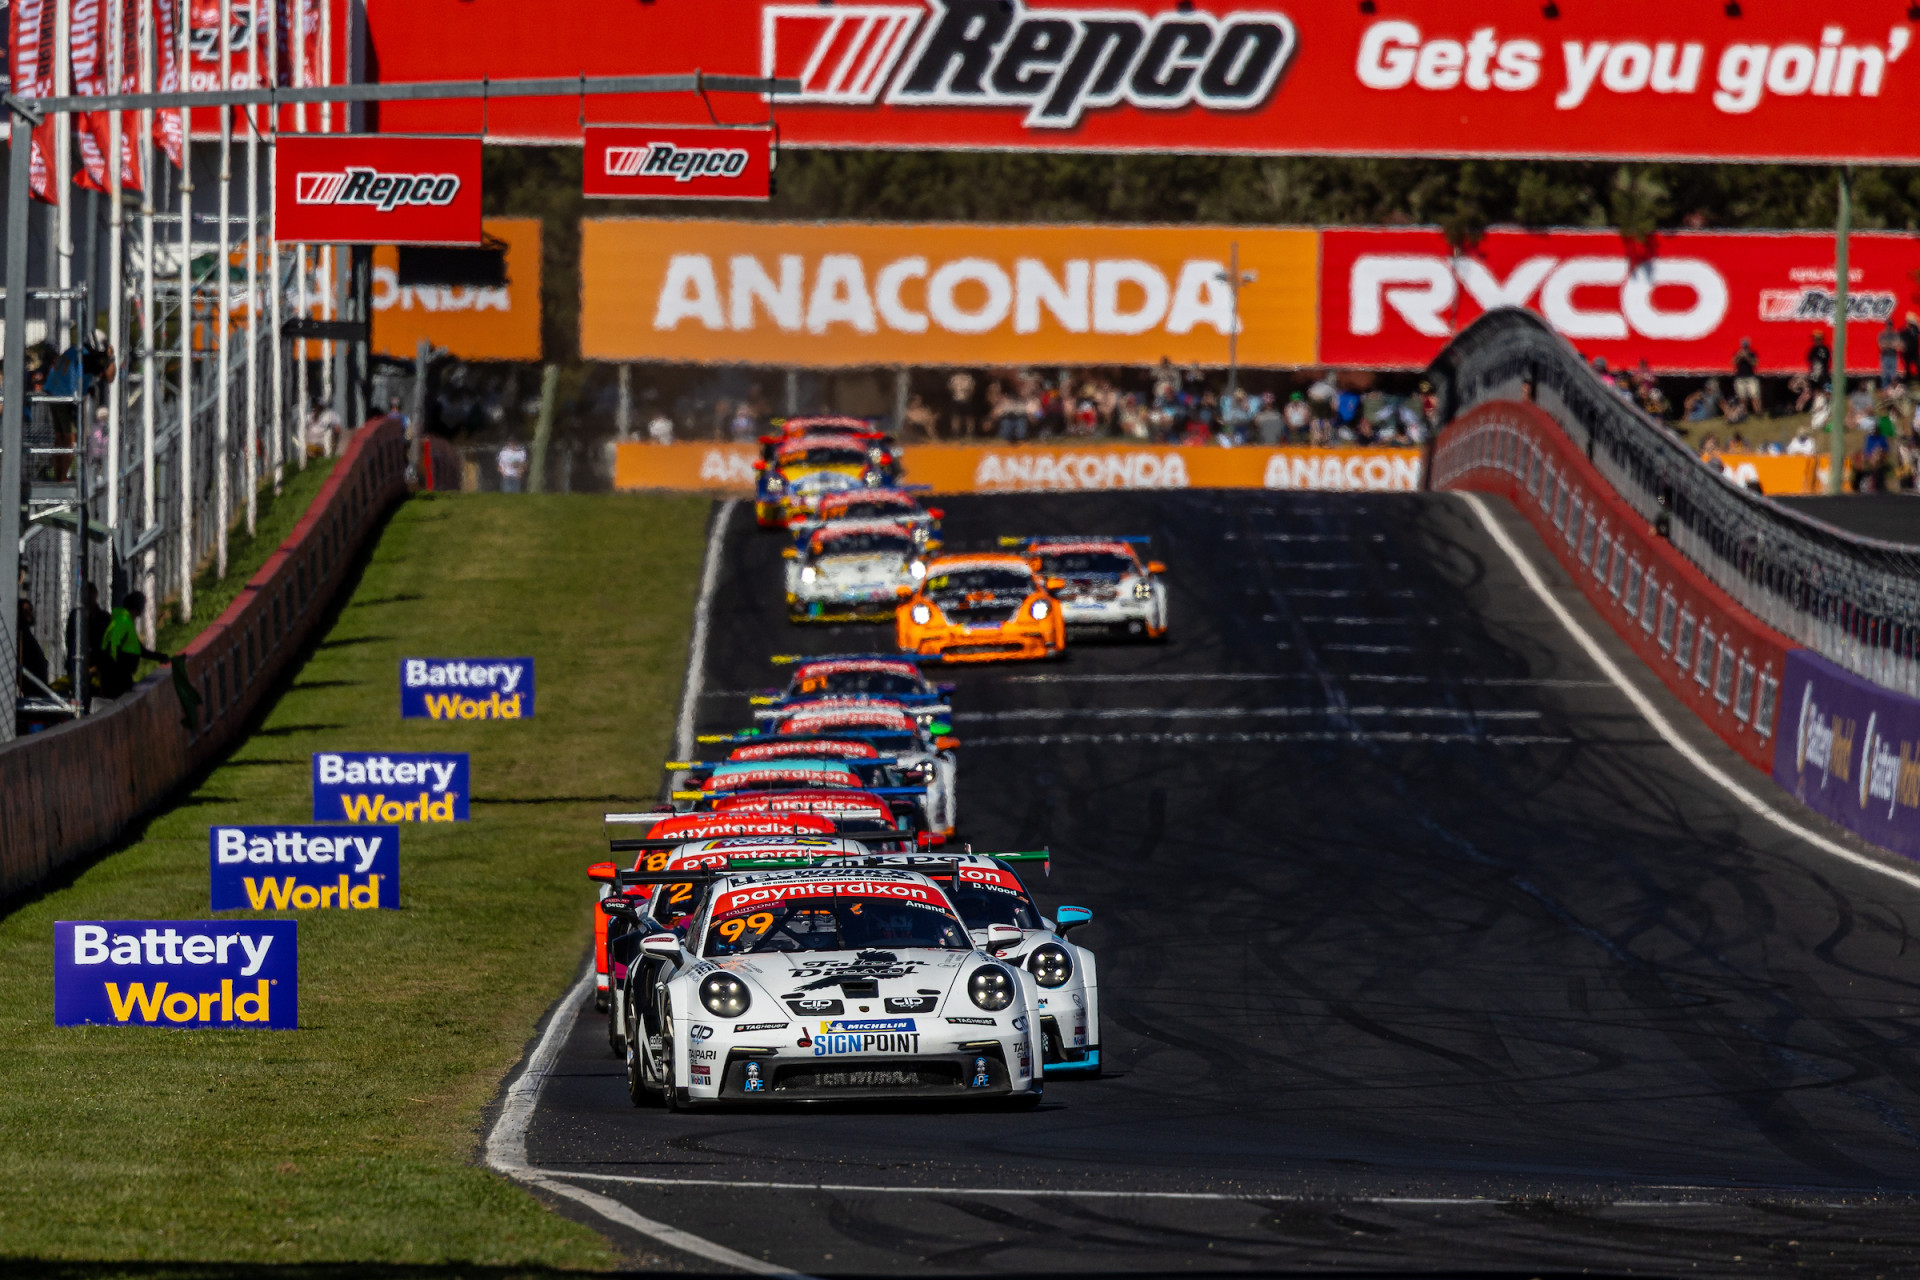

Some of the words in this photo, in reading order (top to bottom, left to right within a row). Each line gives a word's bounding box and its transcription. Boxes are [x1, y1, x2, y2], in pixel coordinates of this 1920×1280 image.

[886, 0, 1294, 128] Repco
[1356, 20, 1542, 90] Gets
[1555, 40, 1705, 110] you
[643, 143, 749, 182] Repco
[337, 167, 461, 211] Repco
[653, 253, 1243, 335] ANACONDA
[1349, 255, 1729, 340] RYCO
[975, 452, 1190, 487] ANACONDA
[405, 659, 523, 693] Battery
[424, 692, 522, 720] World
[319, 754, 457, 792] Battery
[711, 769, 849, 788] paynterdixon
[340, 792, 456, 823] World
[729, 799, 874, 813] aynterdixon
[217, 828, 383, 873] Battery
[243, 874, 380, 911] World
[731, 881, 928, 907] paynterdixon
[973, 882, 984, 890] D.
[985, 883, 1017, 897] Wood
[905, 900, 946, 914] Amand
[719, 912, 774, 944] 99
[74, 925, 274, 977] Battery
[104, 979, 270, 1022] World
[847, 1022, 908, 1030] MICHELIN
[814, 1033, 921, 1056] SIGNPOINT
[744, 1079, 764, 1091] APF
[972, 1075, 990, 1087] APF
